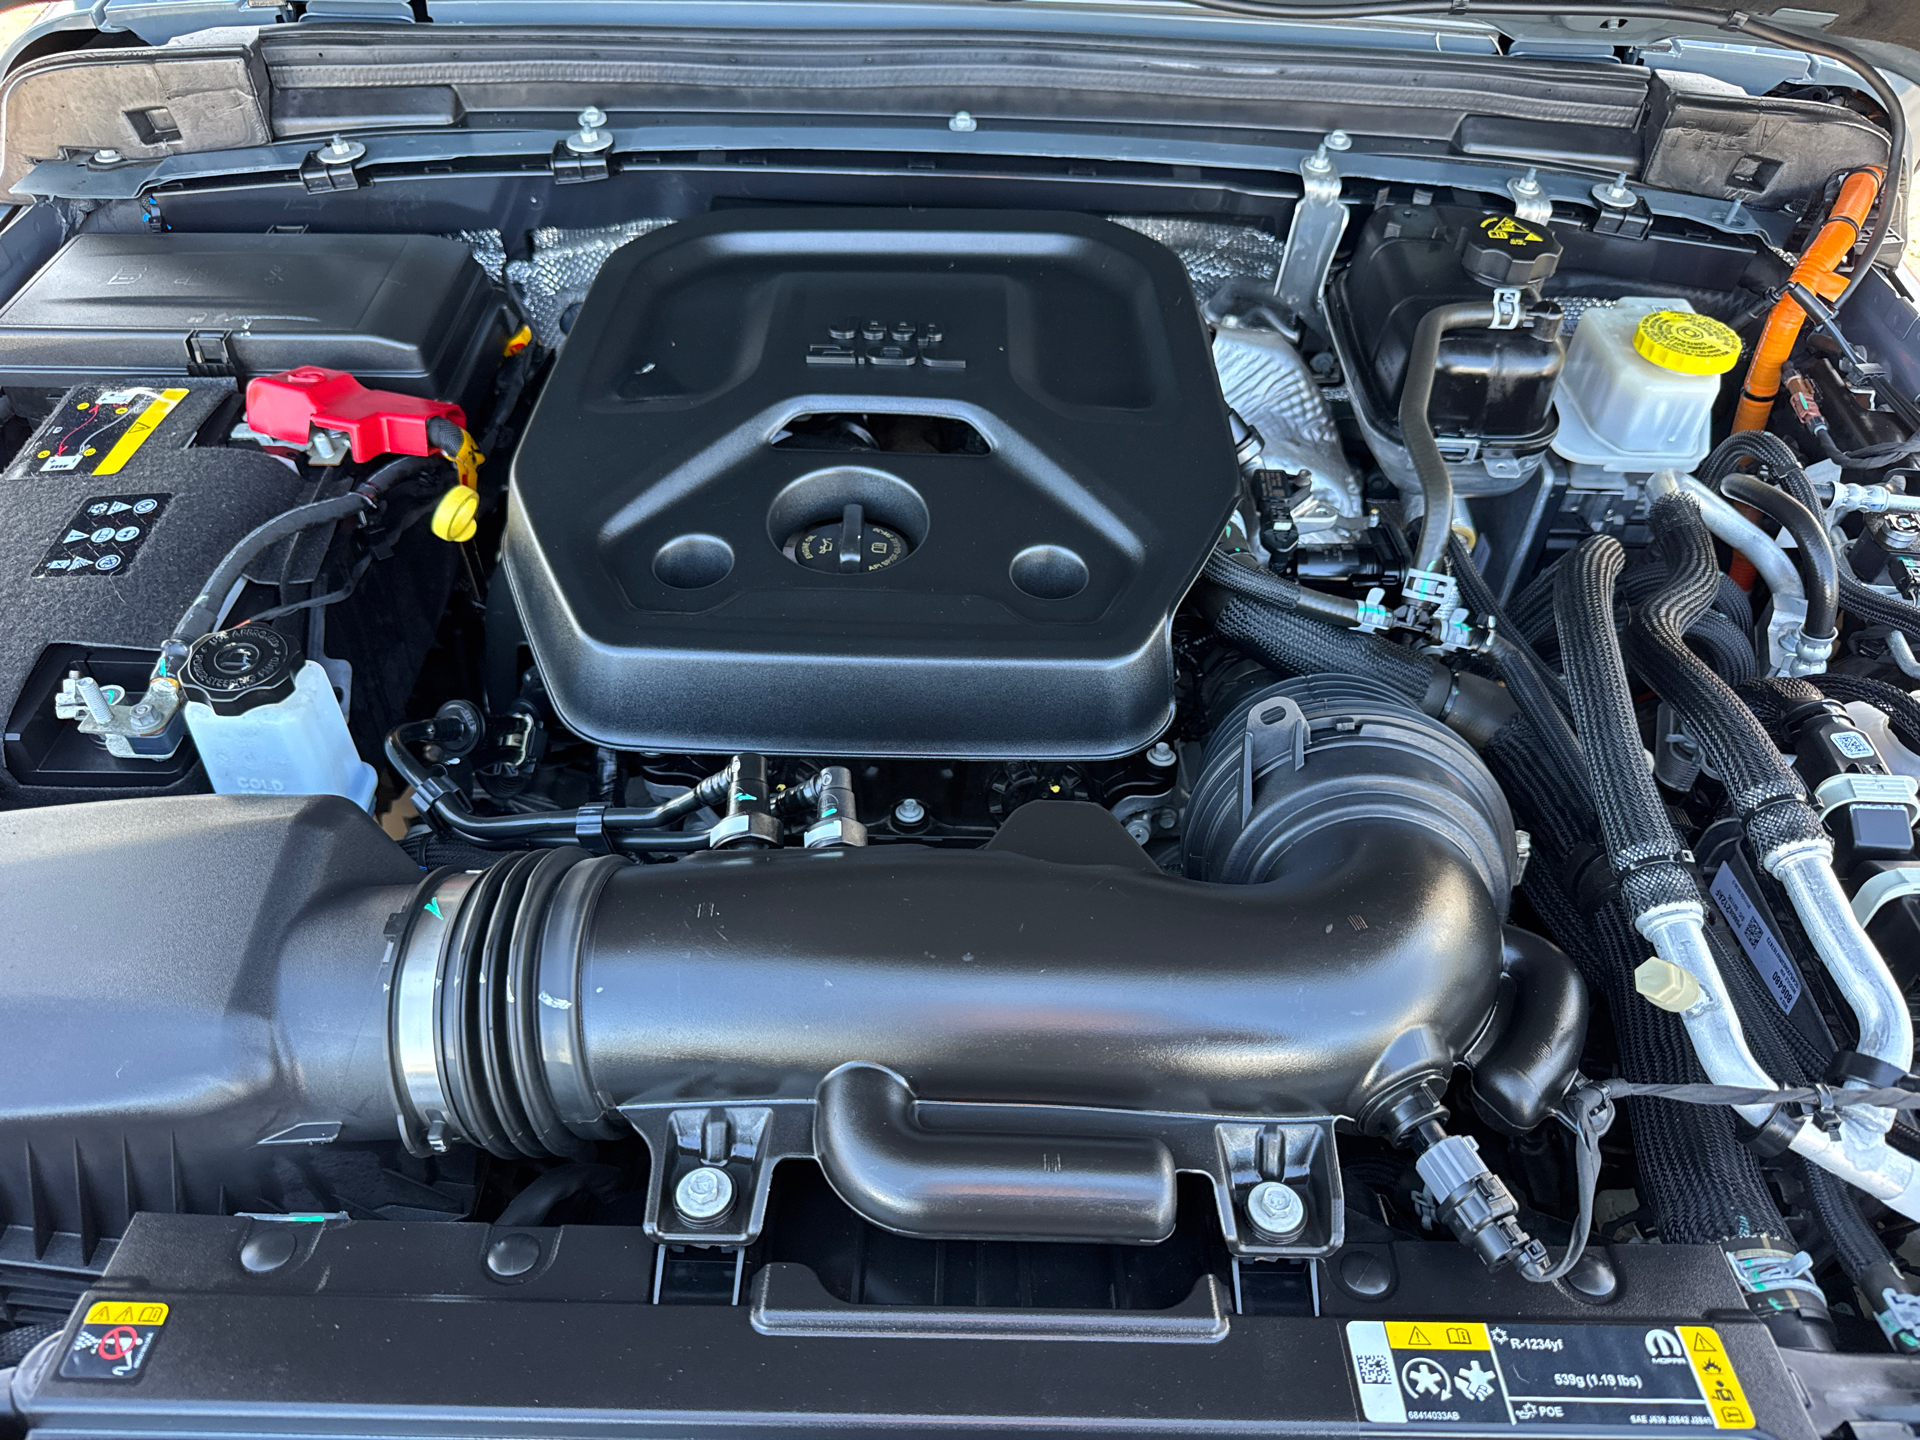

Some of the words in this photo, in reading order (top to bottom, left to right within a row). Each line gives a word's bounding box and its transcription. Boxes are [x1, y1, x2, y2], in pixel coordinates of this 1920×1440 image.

[828, 317, 943, 346] Jeep
[802, 542, 814, 560] ENGINE
[231, 628, 280, 648] APPROVED
[237, 777, 284, 792] COLD
[1772, 971, 1793, 1004] 806480
[1510, 1338, 1563, 1353] R-1234yf
[1651, 1357, 1688, 1365] MOPAR
[1554, 1373, 1586, 1388] 539g
[1586, 1374, 1616, 1389] (1.19
[1617, 1374, 1644, 1390] lbs)
[1408, 1411, 1460, 1421] 68414033AB
[1539, 1406, 1564, 1418] POE
[1629, 1414, 1648, 1424] SAE
